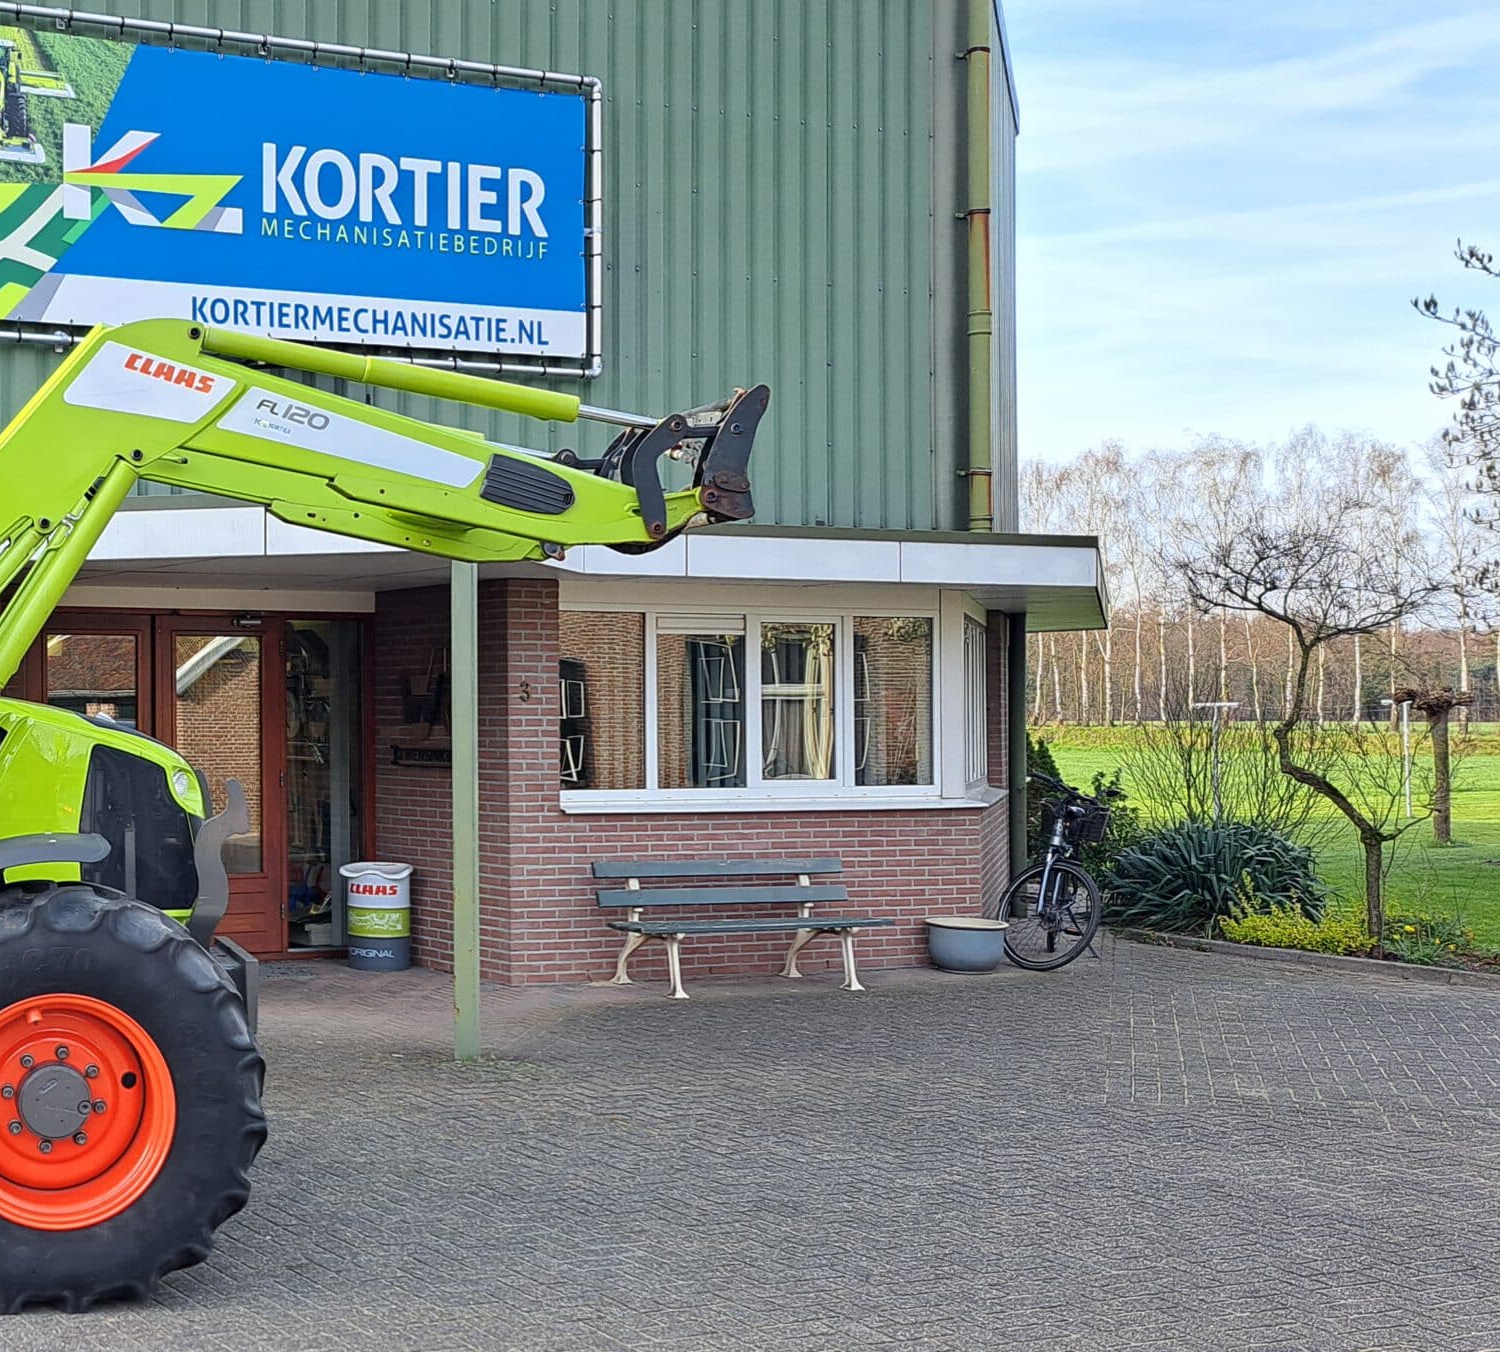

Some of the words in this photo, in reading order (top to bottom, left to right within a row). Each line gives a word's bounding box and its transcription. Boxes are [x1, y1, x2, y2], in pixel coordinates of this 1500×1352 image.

[262, 141, 549, 238] KORTIER
[261, 217, 549, 260] MECHANISATIEBEDRIJF
[191, 296, 550, 346] KORTIERMECHANISATIE.NL
[124, 352, 216, 394] CLAAS
[519, 680, 530, 703] 3
[349, 883, 398, 896] CLAAS
